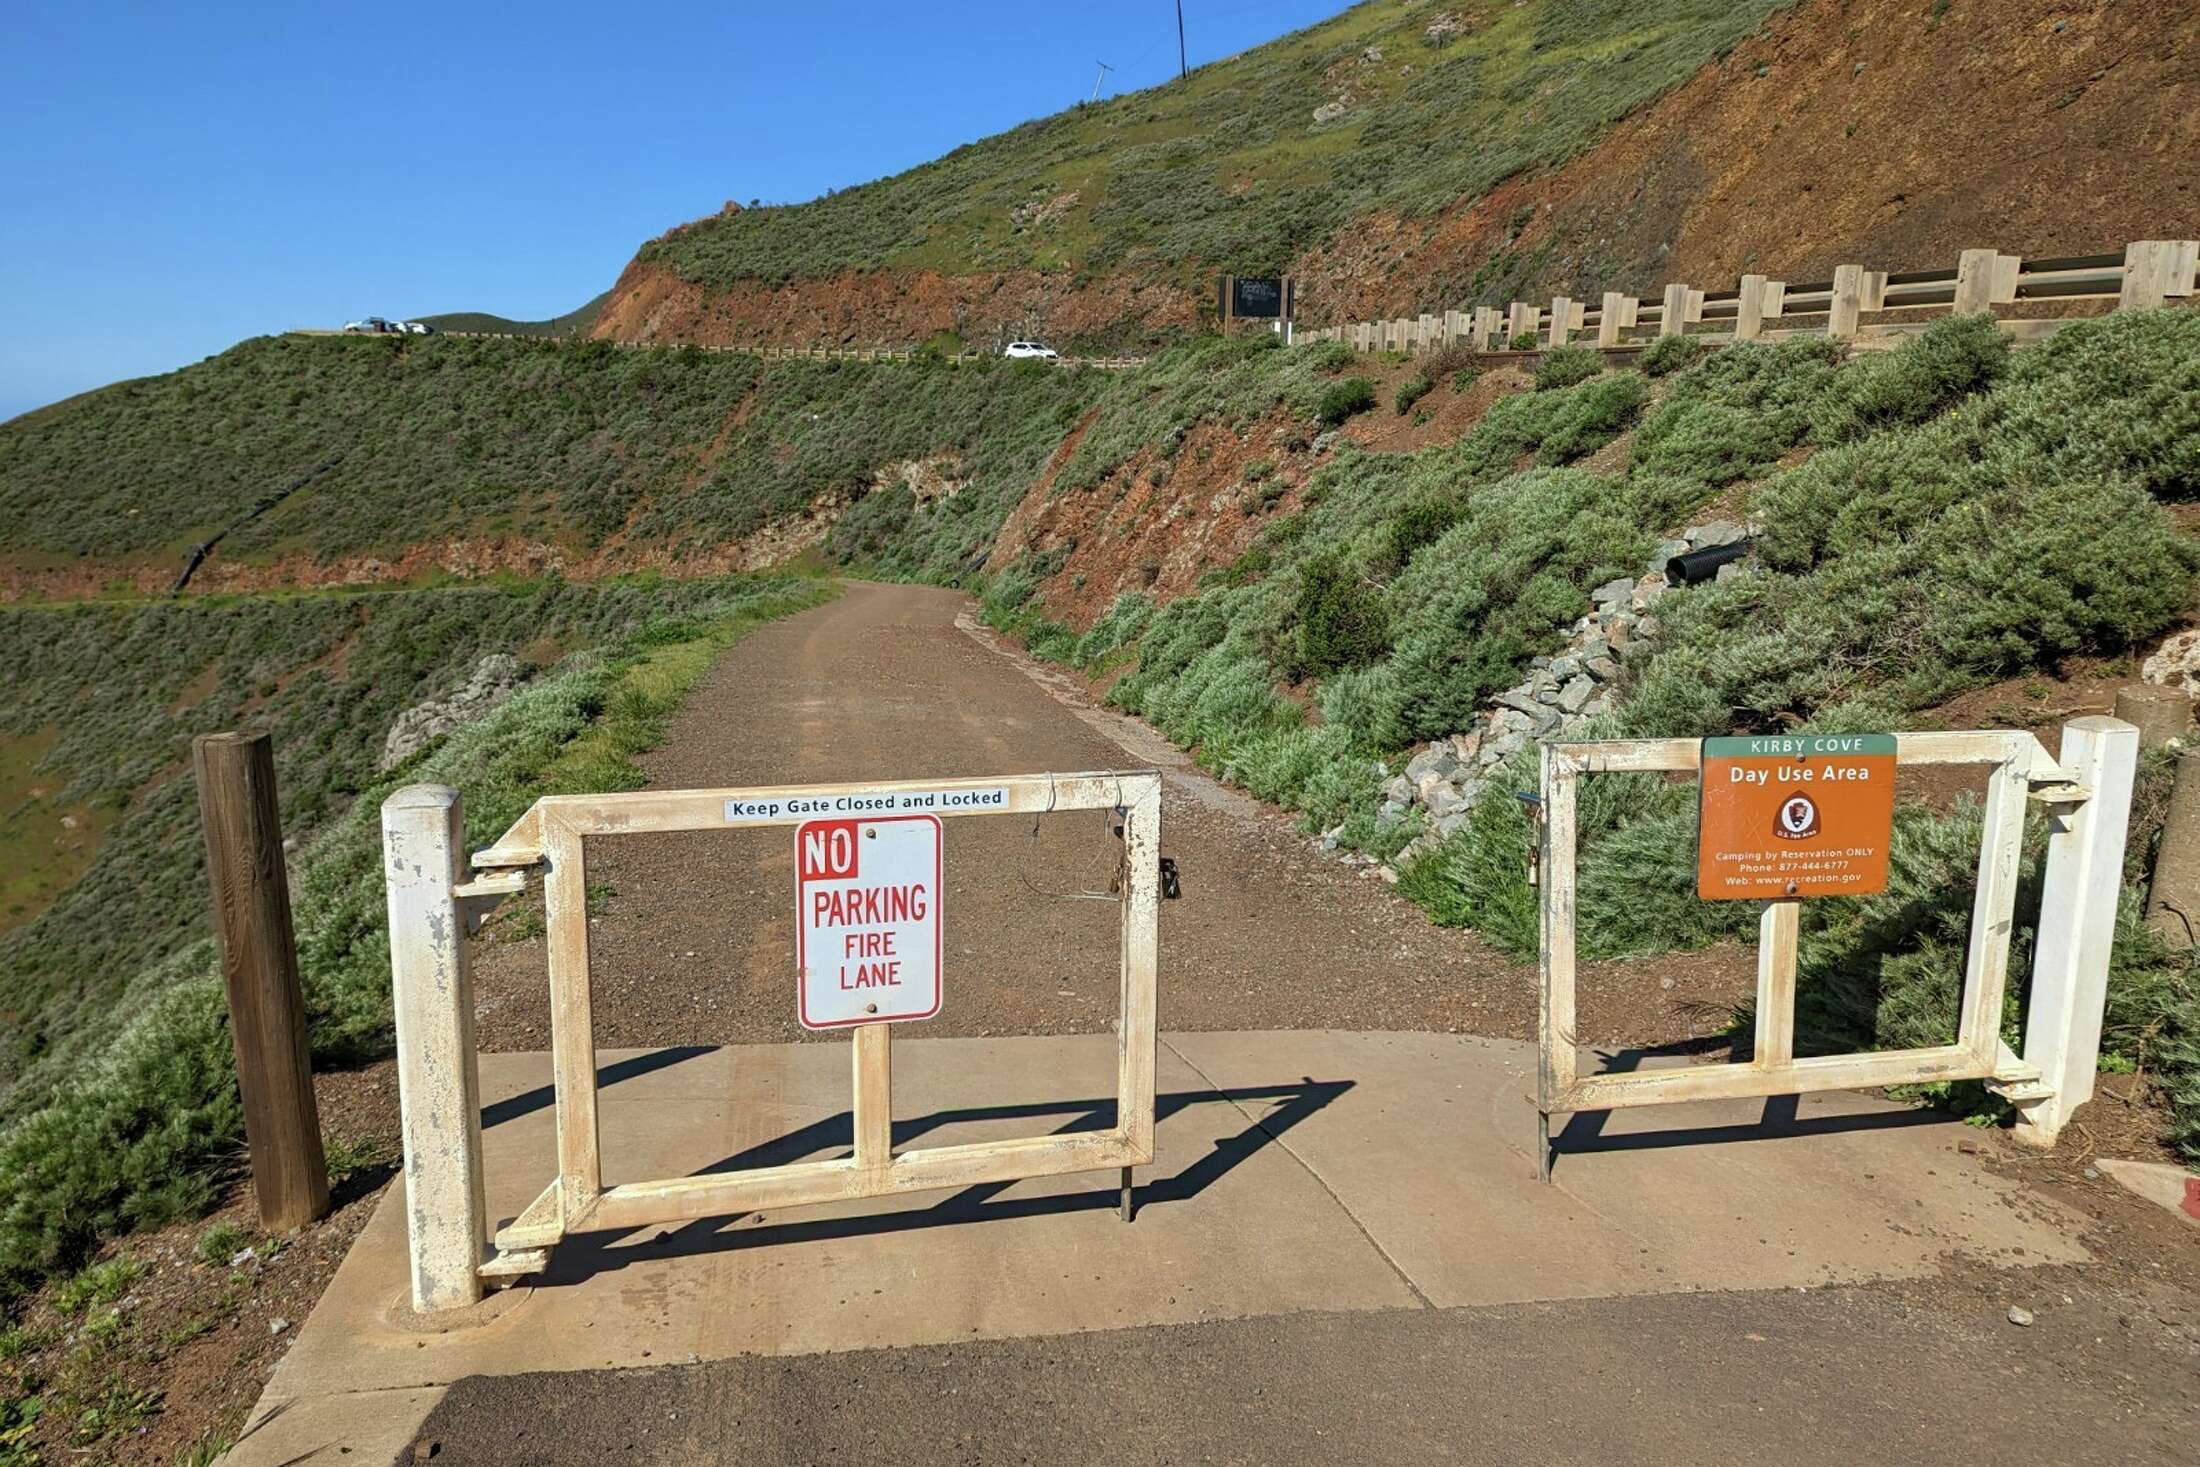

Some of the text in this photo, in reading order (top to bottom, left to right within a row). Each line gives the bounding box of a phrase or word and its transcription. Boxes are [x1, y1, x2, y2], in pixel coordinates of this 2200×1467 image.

[1751, 738, 1863, 753] KIRBY COVE
[1730, 765, 1869, 786] Day Use Area
[733, 790, 1002, 818] Keep Gate Closed and Locked
[804, 827, 851, 875] NO
[1715, 847, 1874, 862] Camping by Reservation ONLY
[1739, 860, 1849, 873] Phone: 877-444-6777
[1725, 873, 1862, 886] Web: www.recreation.gov
[814, 884, 927, 929] PARKING
[845, 932, 897, 959] FIRE
[840, 961, 902, 991] LANE
